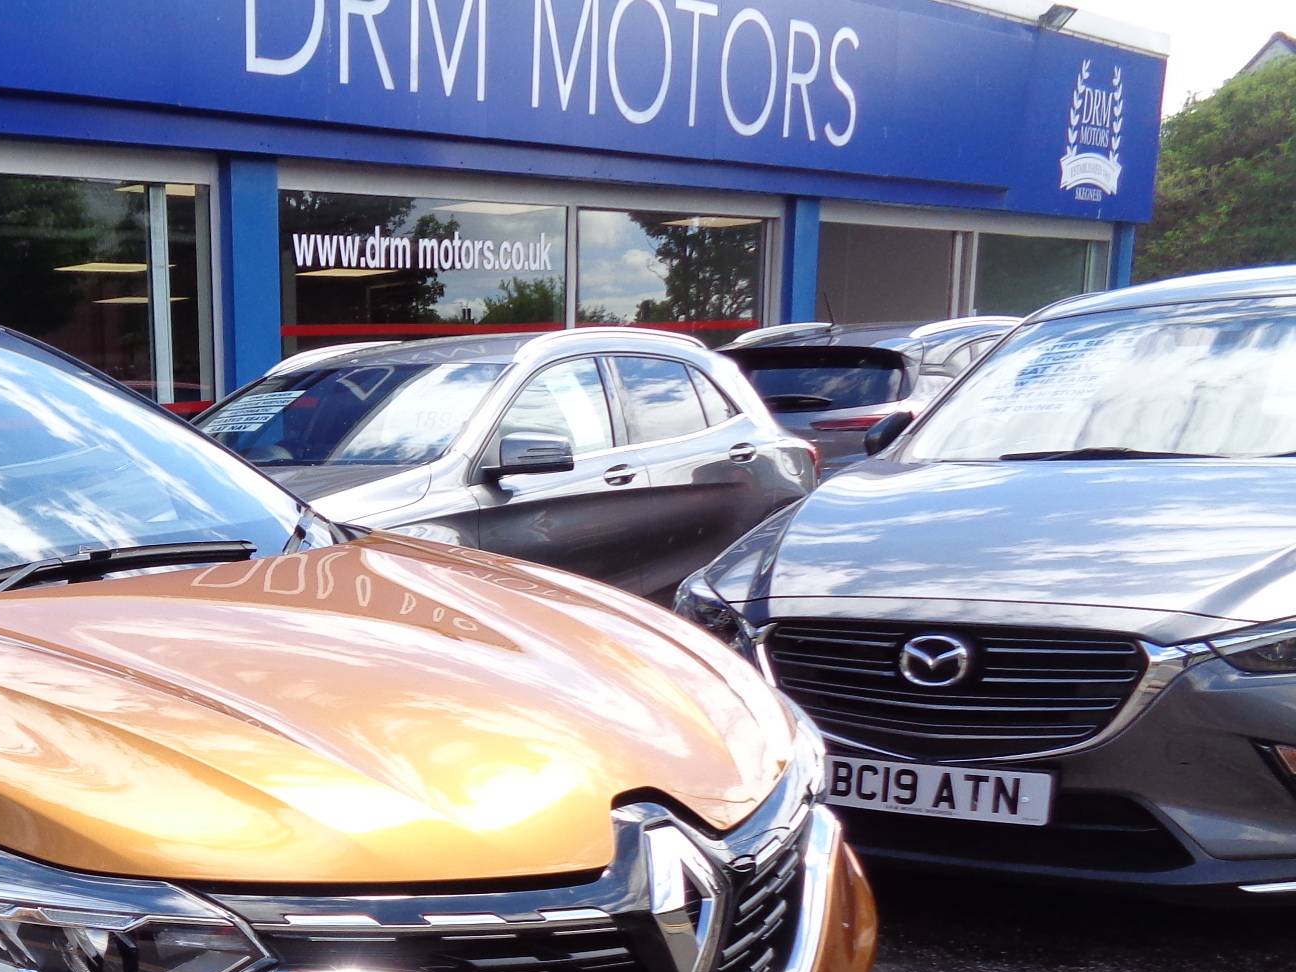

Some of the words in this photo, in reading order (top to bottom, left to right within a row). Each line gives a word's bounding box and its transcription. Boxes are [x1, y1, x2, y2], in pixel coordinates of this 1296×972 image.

[245, 0, 487, 102] DRM
[531, 0, 860, 148] MOTORS
[1082, 88, 1113, 127] DRM
[1079, 126, 1110, 148] MOTORS
[829, 761, 919, 805] BC19
[932, 772, 1021, 815] ATN
